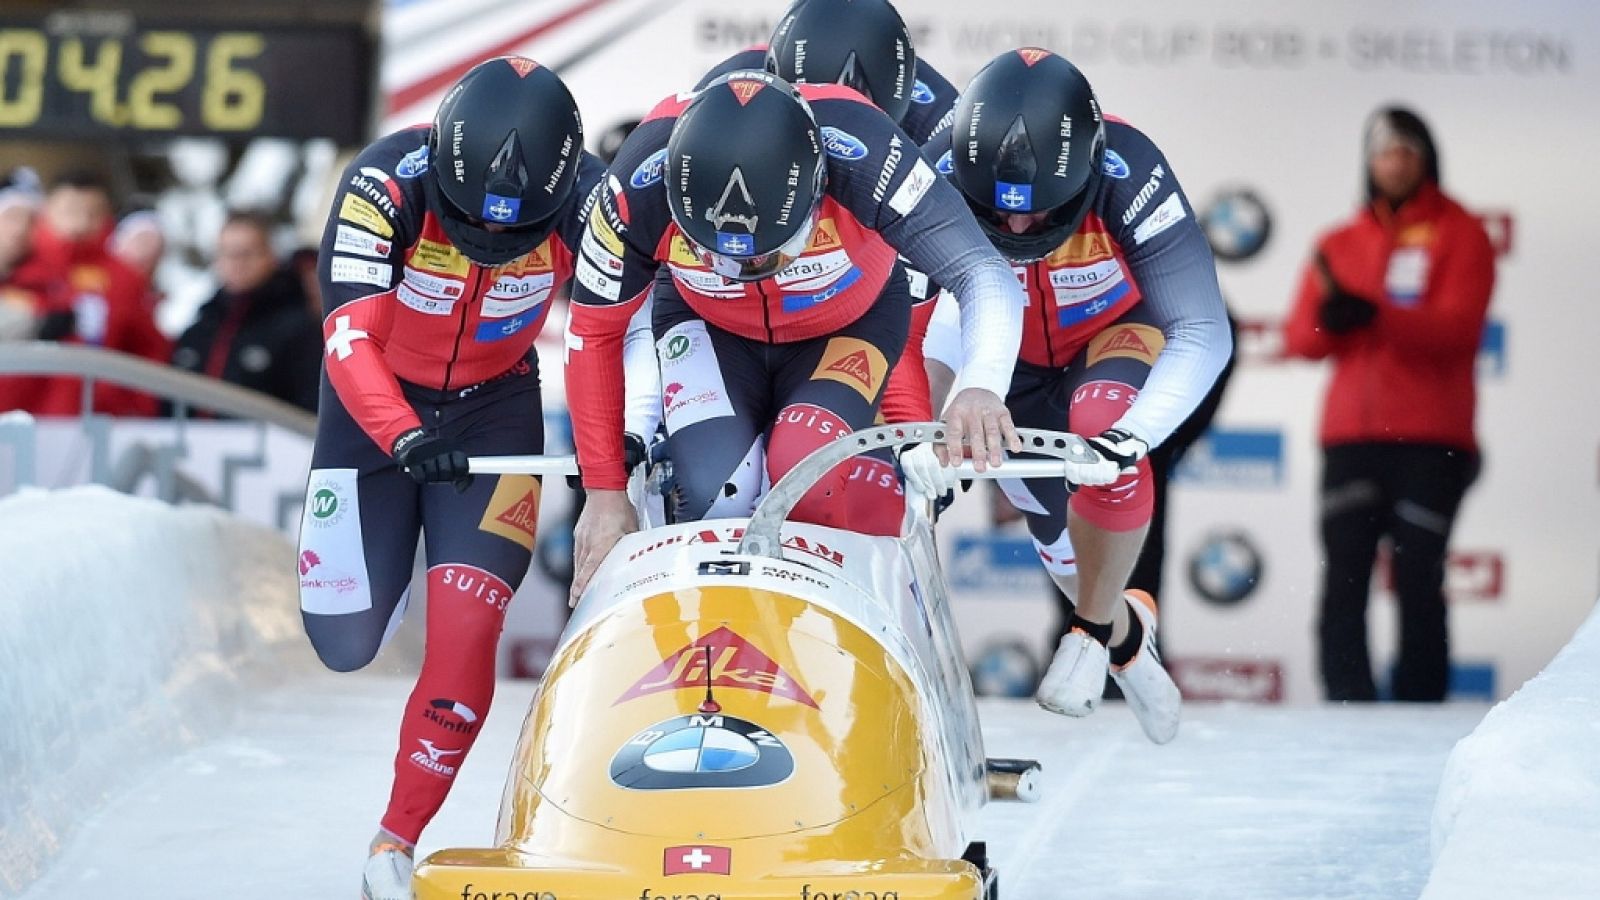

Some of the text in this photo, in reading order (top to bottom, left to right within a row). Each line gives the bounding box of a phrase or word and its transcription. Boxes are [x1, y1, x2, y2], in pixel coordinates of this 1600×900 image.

[640, 646, 788, 691] Sika
[422, 708, 474, 735] skinfit
[629, 715, 782, 748] BMW
